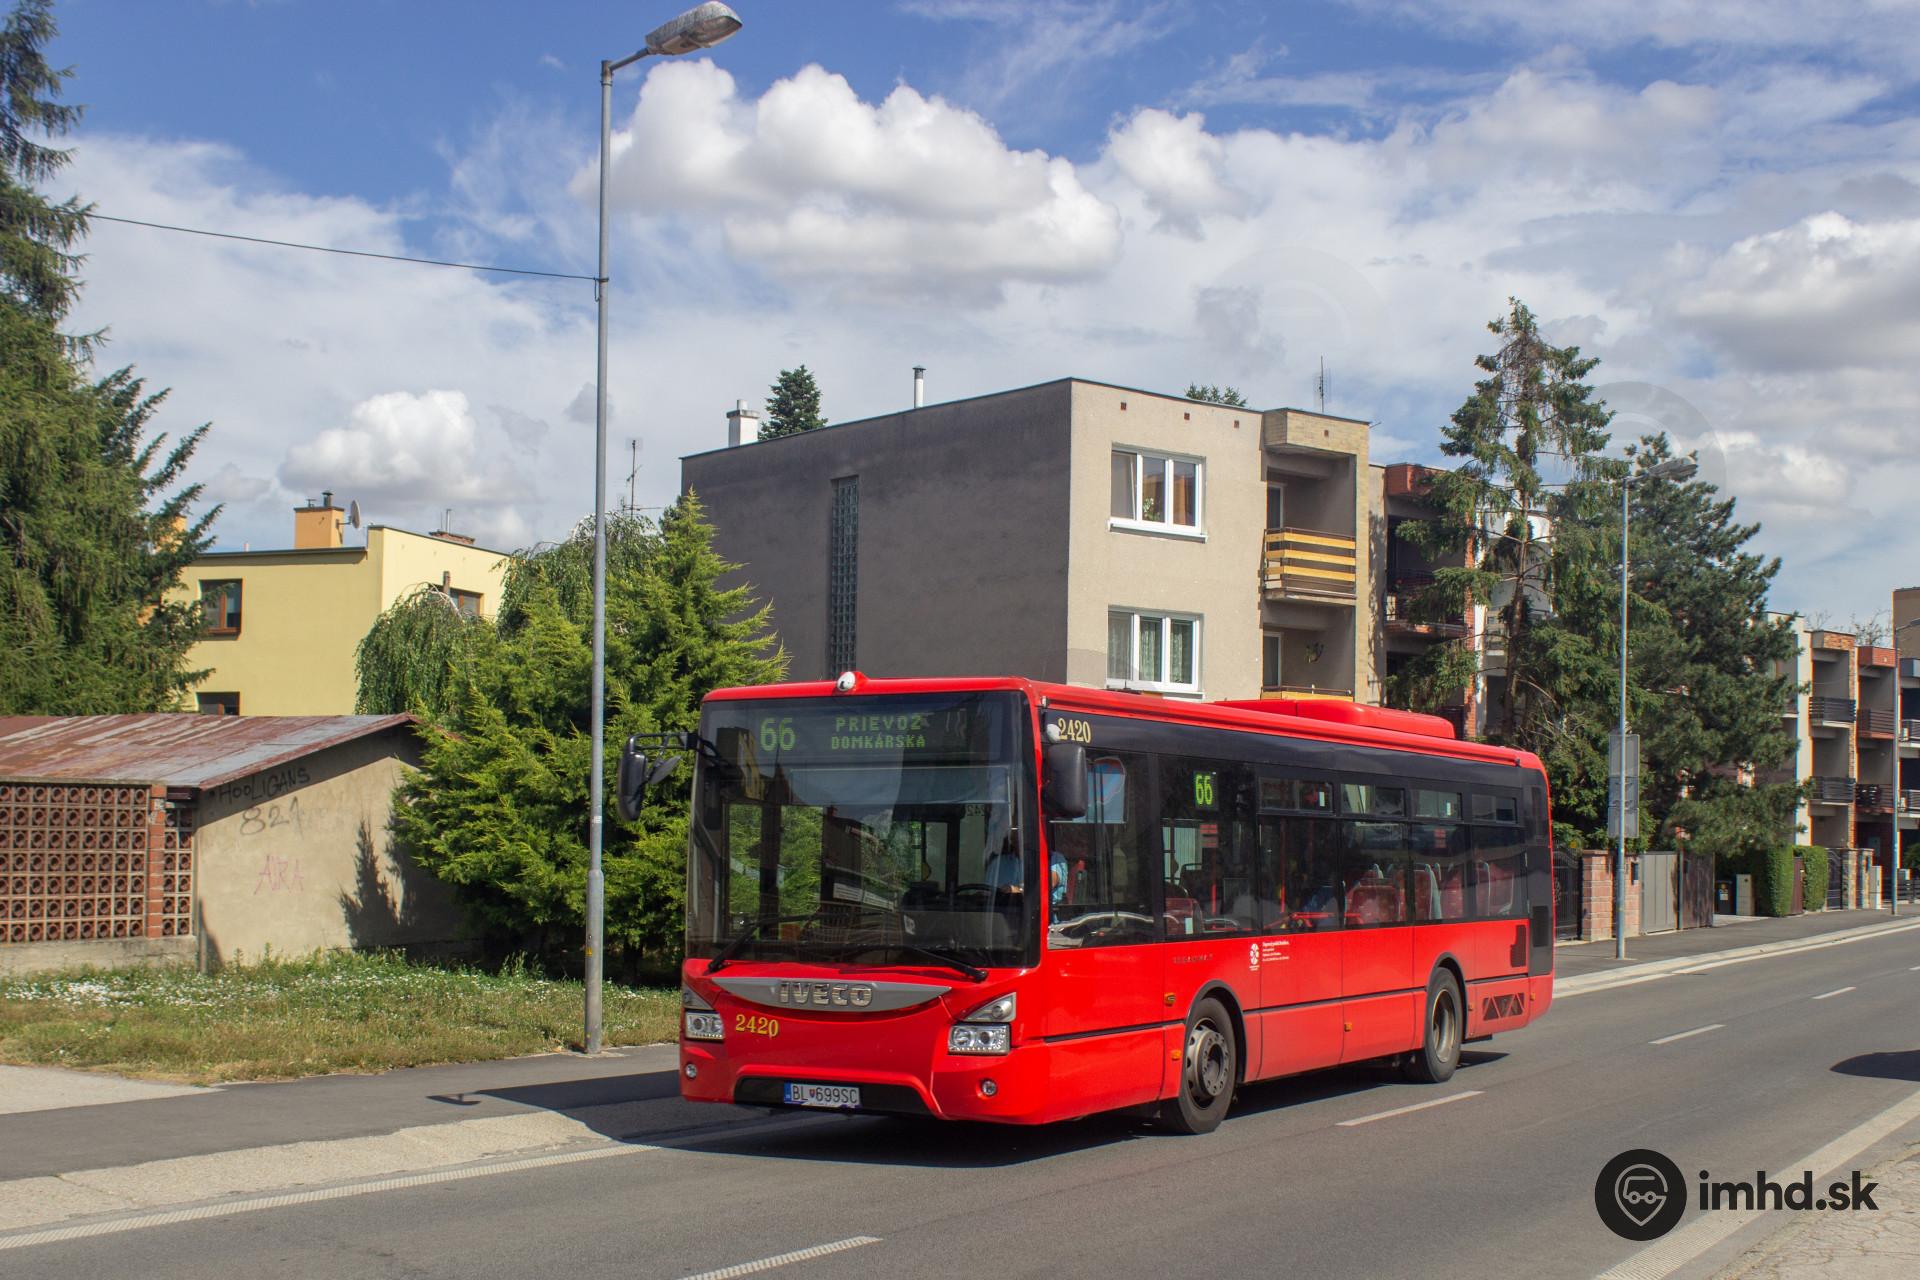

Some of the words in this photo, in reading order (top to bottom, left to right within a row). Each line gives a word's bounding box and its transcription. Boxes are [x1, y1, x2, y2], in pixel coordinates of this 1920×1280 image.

[760, 718, 796, 751] 66
[835, 714, 922, 733] PRIEVOZ
[1057, 717, 1092, 743] 2420
[1195, 774, 1213, 805] 66
[779, 981, 873, 1007] IVECO
[735, 1014, 779, 1038] 2420
[792, 1085, 809, 1101] BL
[815, 1087, 858, 1104] 699SC
